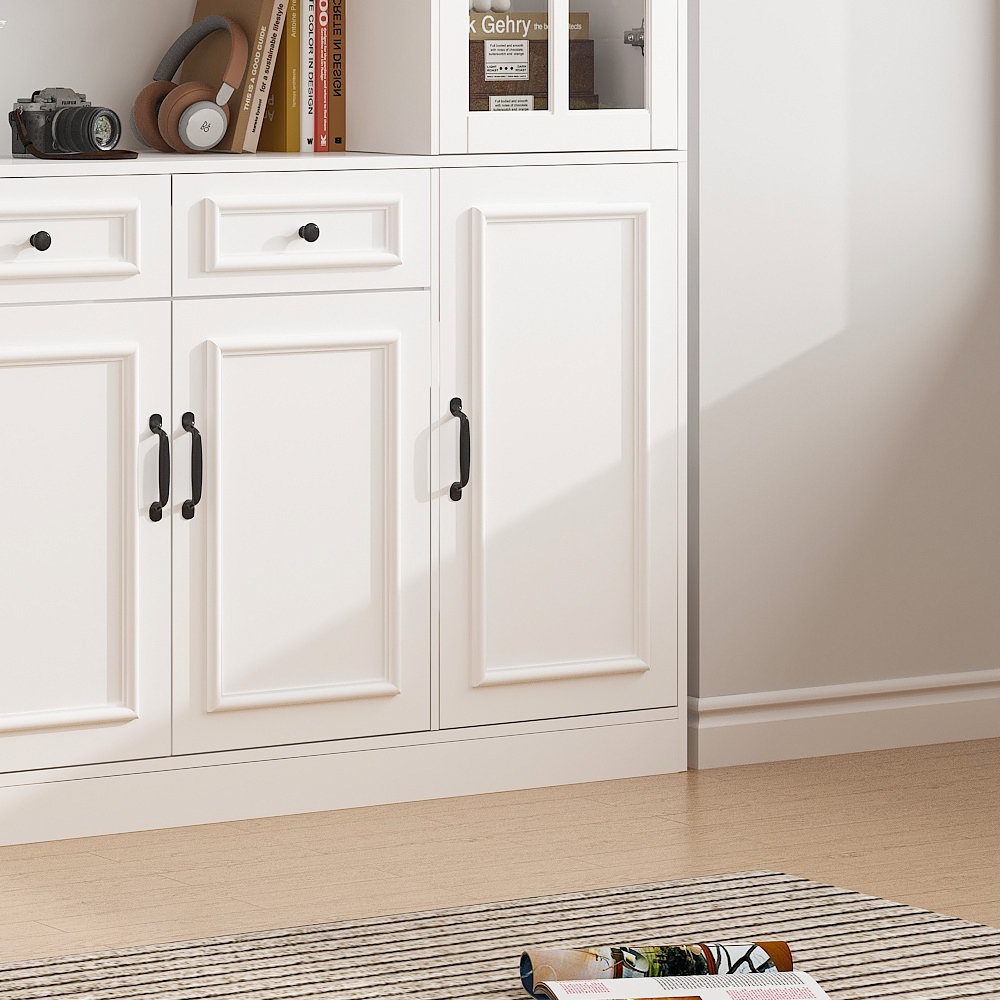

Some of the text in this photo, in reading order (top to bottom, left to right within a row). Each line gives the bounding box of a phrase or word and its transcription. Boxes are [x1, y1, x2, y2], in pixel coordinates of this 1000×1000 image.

[259, 81, 267, 93] for
[264, 32, 278, 74] sustainable
[272, 3, 284, 32] lifestyle
[481, 15, 532, 38] Gehry
[243, 93, 252, 111] THIS
[251, 51, 261, 76] GOOD
[256, 25, 267, 51] GUIDE
[308, 58, 314, 69] IN
